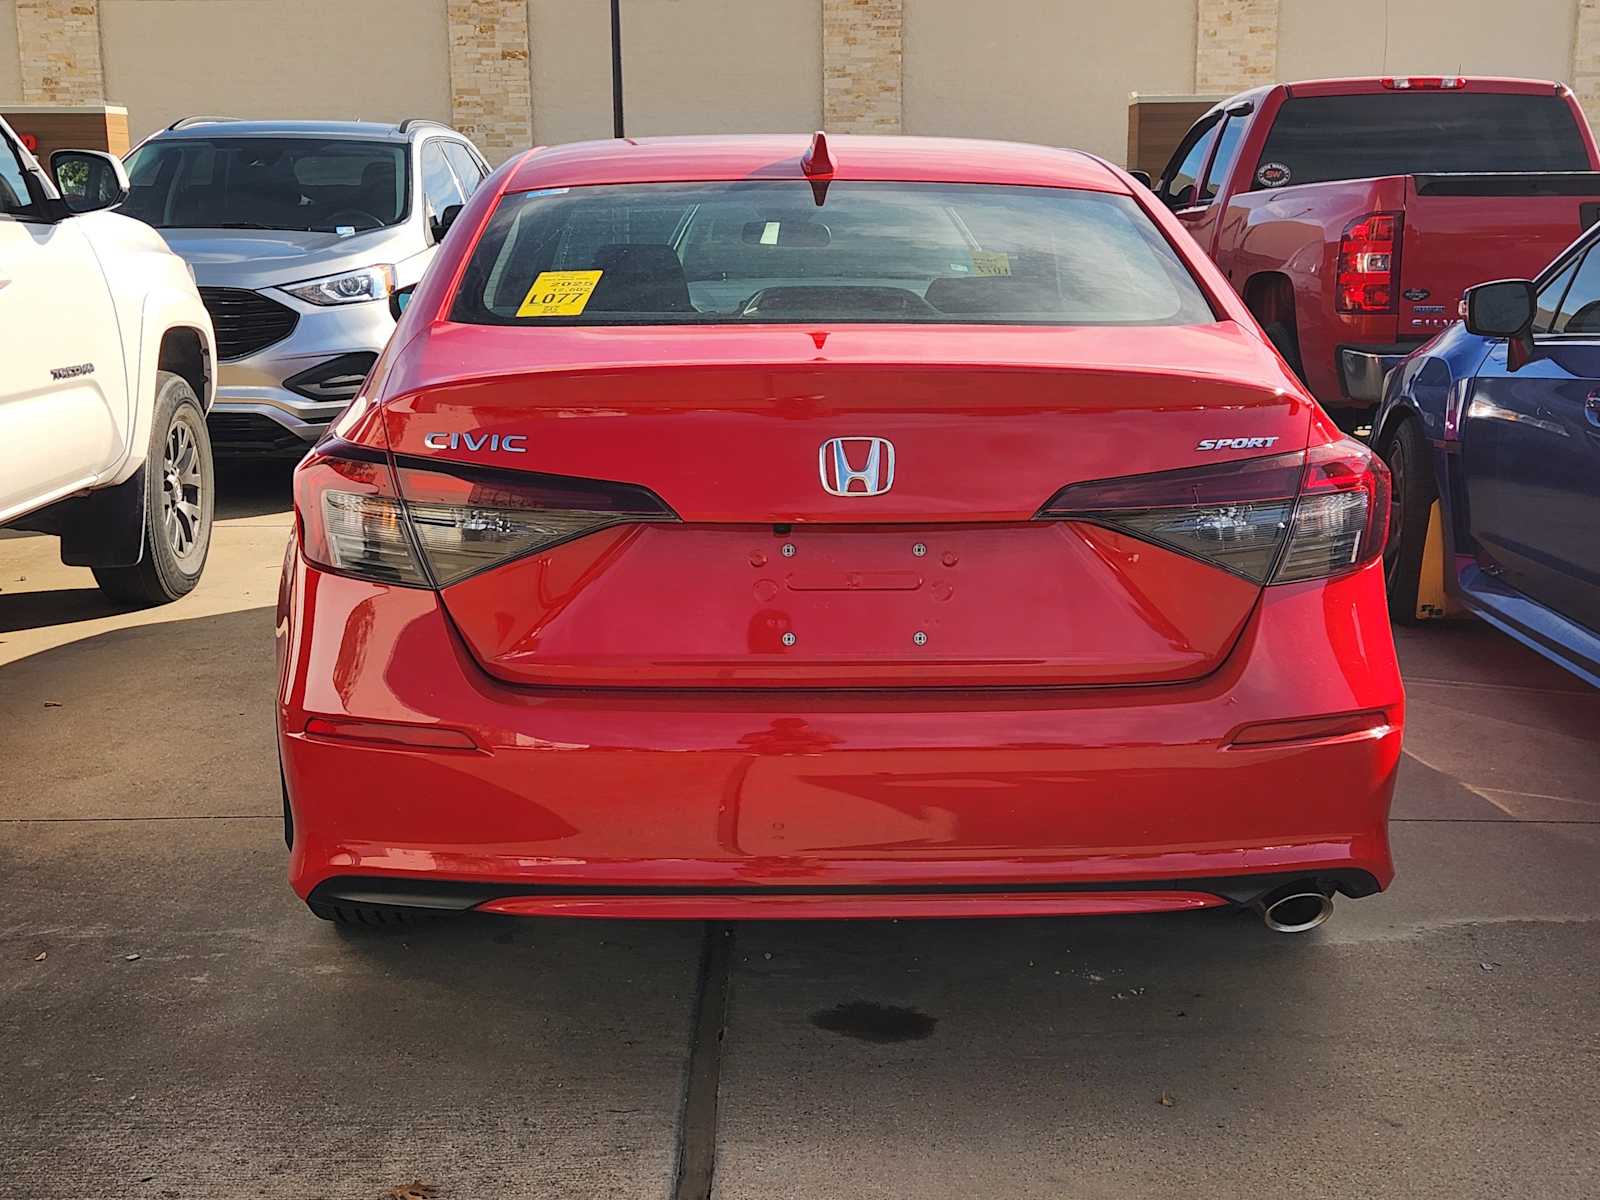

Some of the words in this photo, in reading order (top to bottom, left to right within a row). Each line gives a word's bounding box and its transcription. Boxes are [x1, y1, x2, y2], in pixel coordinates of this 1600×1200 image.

[529, 293, 583, 304] L077
[1411, 319, 1463, 327] SILV
[424, 432, 528, 452] CIVIC
[1196, 436, 1279, 451] SPORT
